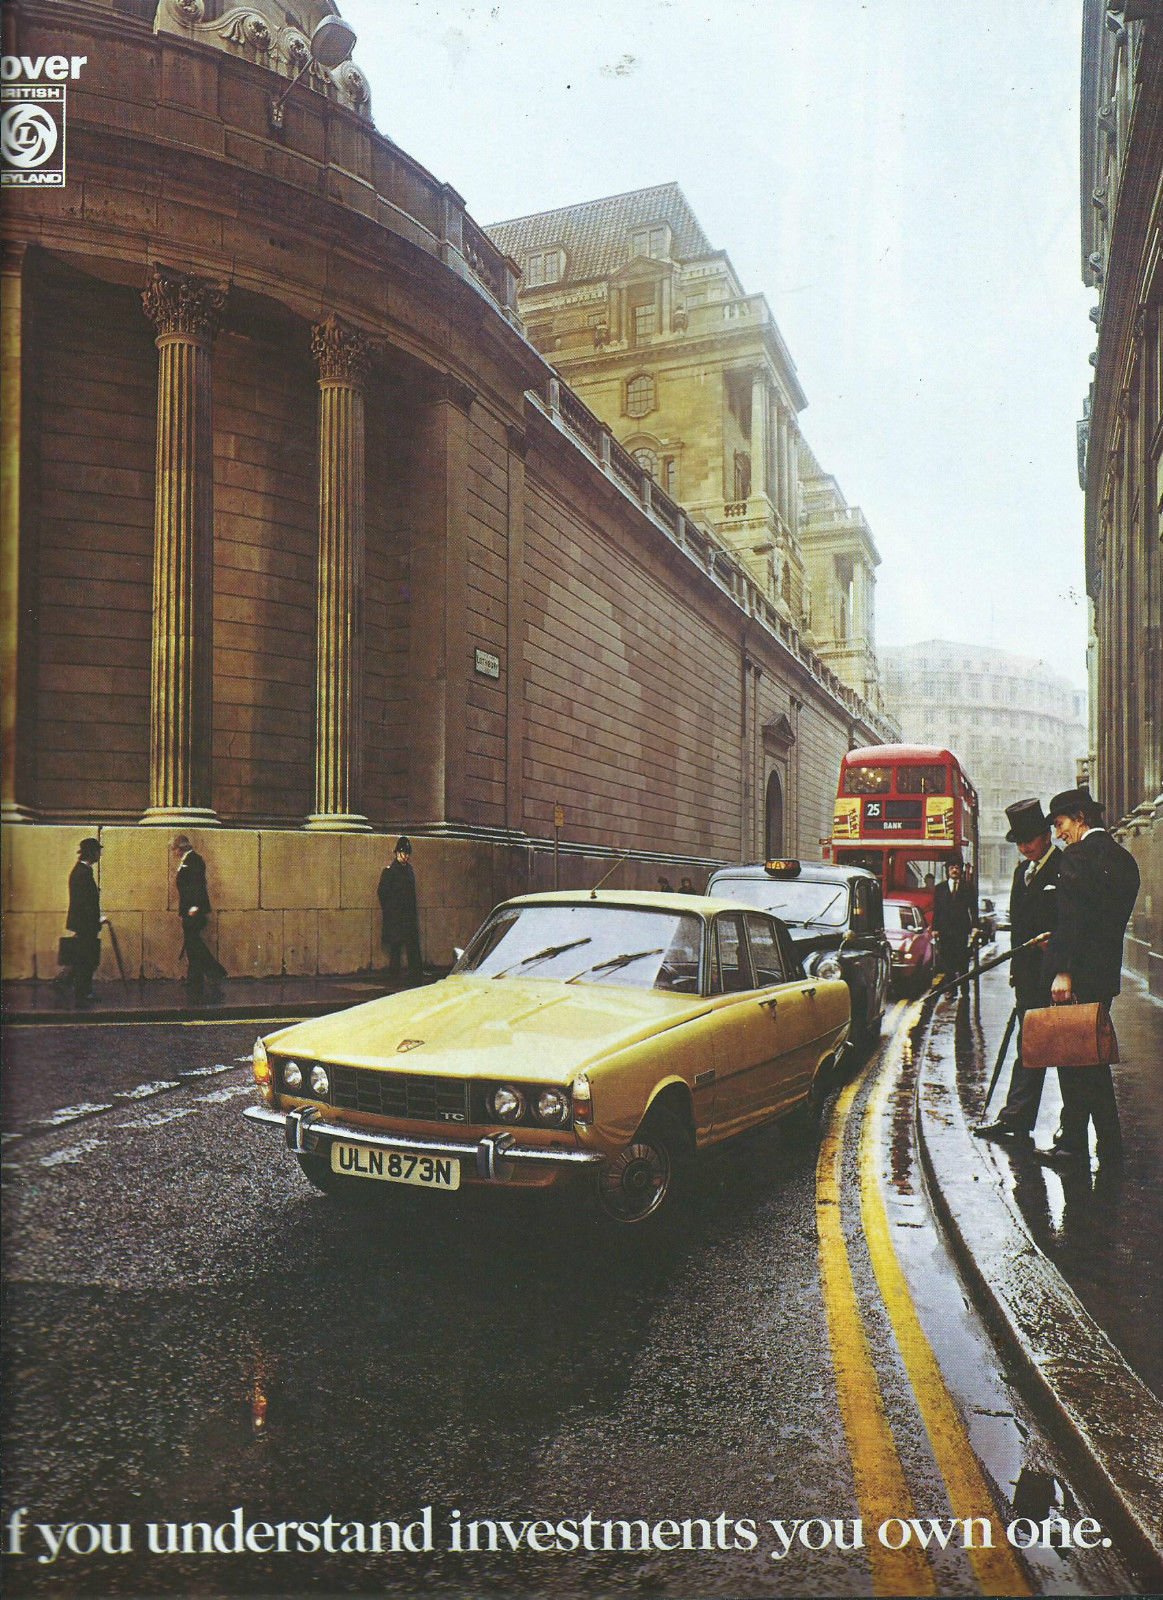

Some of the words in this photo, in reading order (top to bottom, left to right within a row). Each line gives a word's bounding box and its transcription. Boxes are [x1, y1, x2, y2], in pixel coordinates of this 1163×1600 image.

[866, 803, 881, 816] 25
[883, 821, 903, 830] BANK
[440, 1111, 465, 1121] TC
[339, 1146, 383, 1176] ULN
[387, 1152, 451, 1186] 873N
